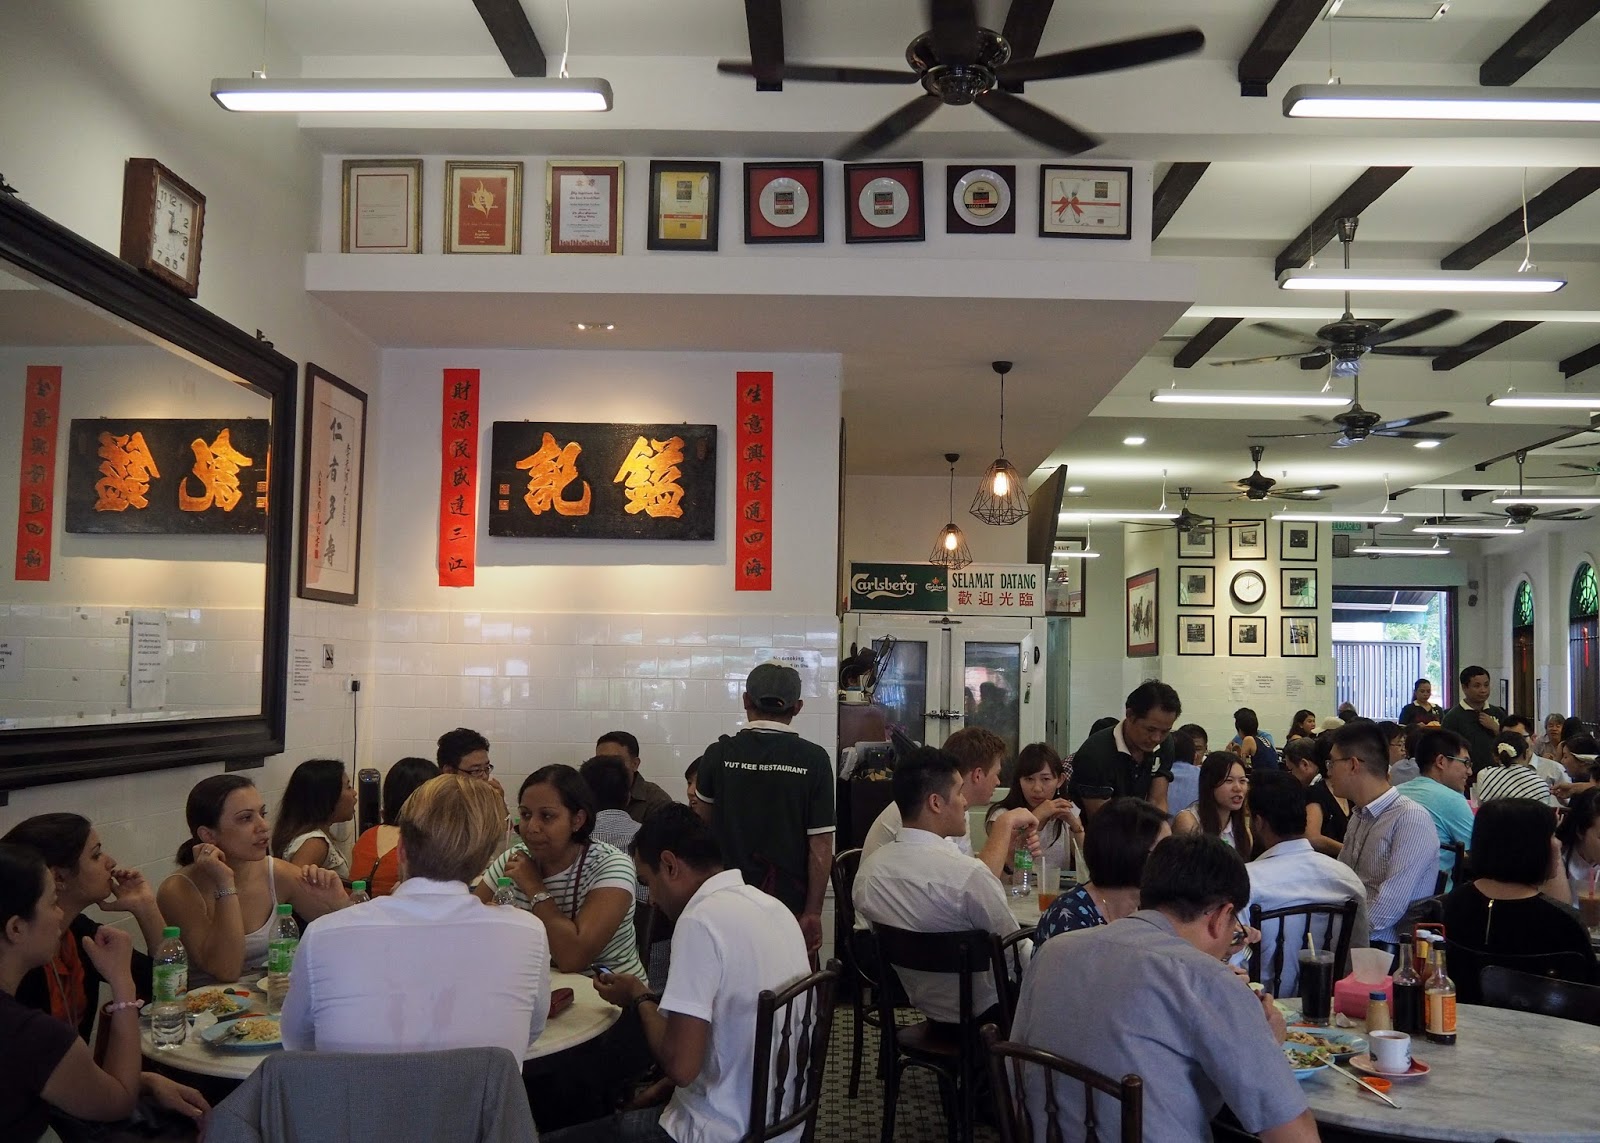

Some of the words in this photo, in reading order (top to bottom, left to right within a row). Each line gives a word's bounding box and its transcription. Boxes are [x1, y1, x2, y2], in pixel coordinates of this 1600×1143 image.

[448, 380, 472, 571] 財源茂盛達三江
[743, 383, 766, 577] 生意興隆通四海
[851, 573, 915, 598] Carlsberg
[952, 572, 994, 588] SELAMAT
[1000, 573, 1036, 589] DATANG
[958, 590, 1034, 607] 歡迎光臨
[724, 761, 740, 769] YUT
[741, 762, 758, 771] KEE
[758, 764, 808, 776] RESTAURANT
